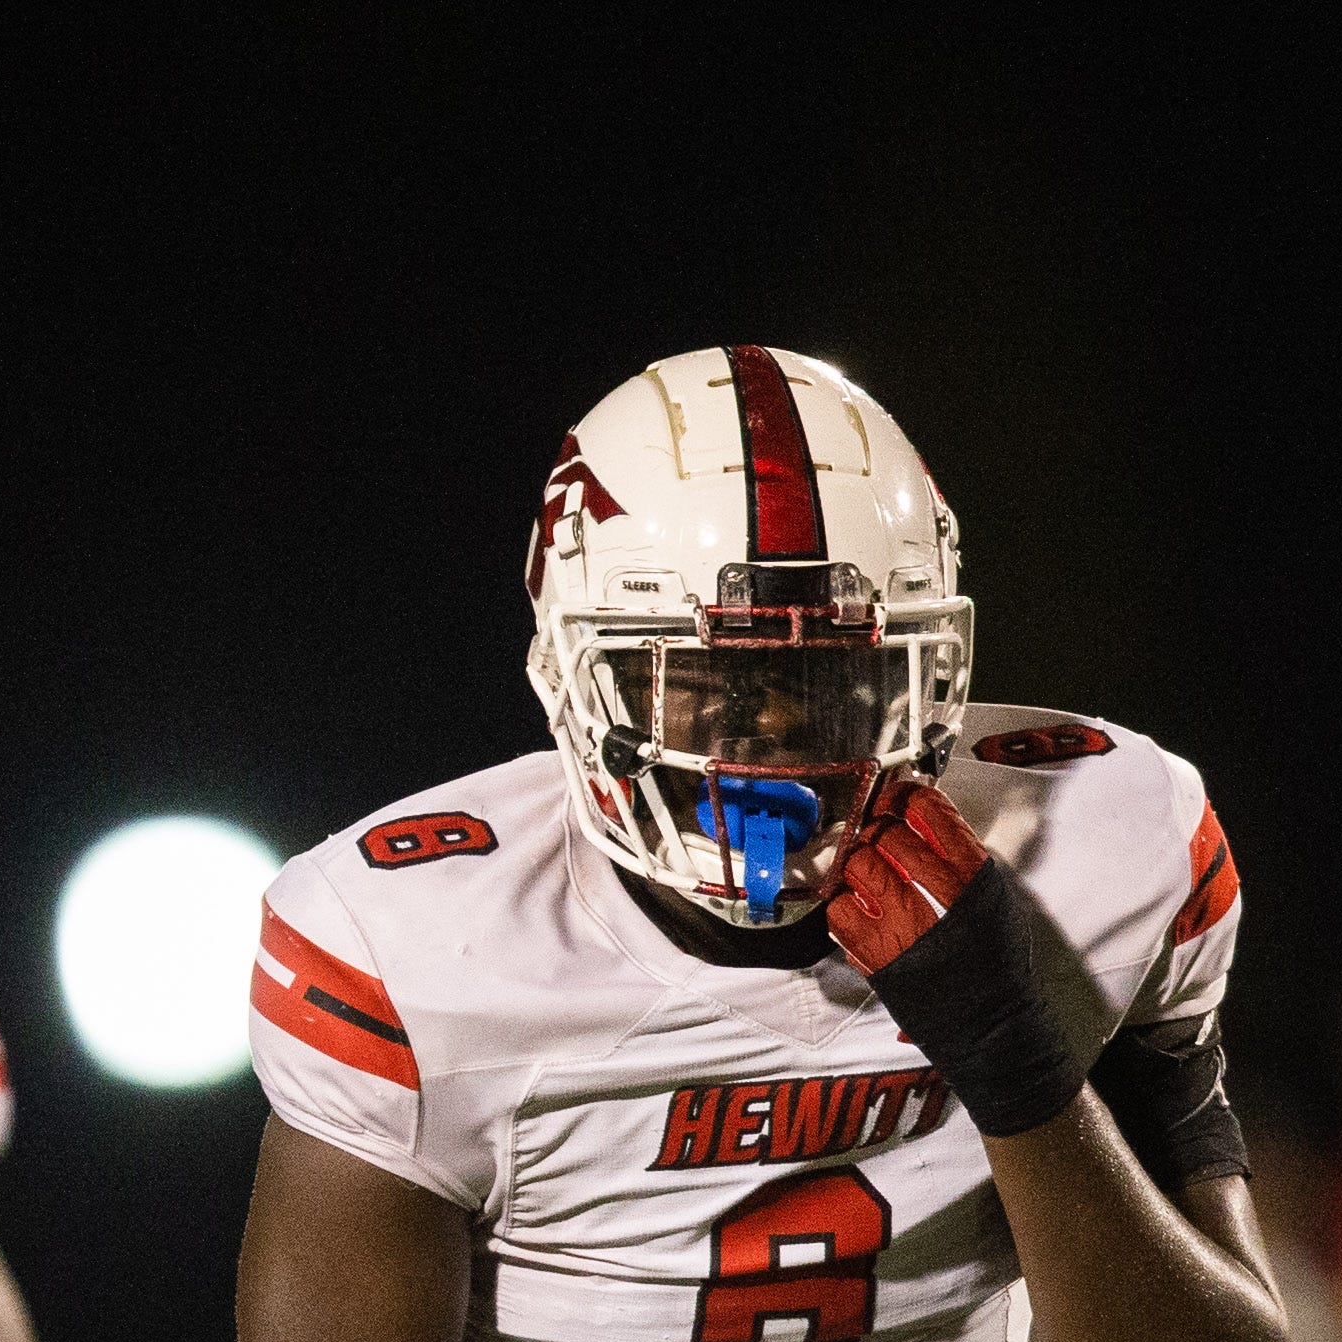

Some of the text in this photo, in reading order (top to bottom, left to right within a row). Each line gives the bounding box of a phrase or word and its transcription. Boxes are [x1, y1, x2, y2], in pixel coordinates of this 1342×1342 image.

[971, 723, 1118, 768] 8
[356, 811, 499, 870] 8
[645, 1066, 948, 1171] HEWITT
